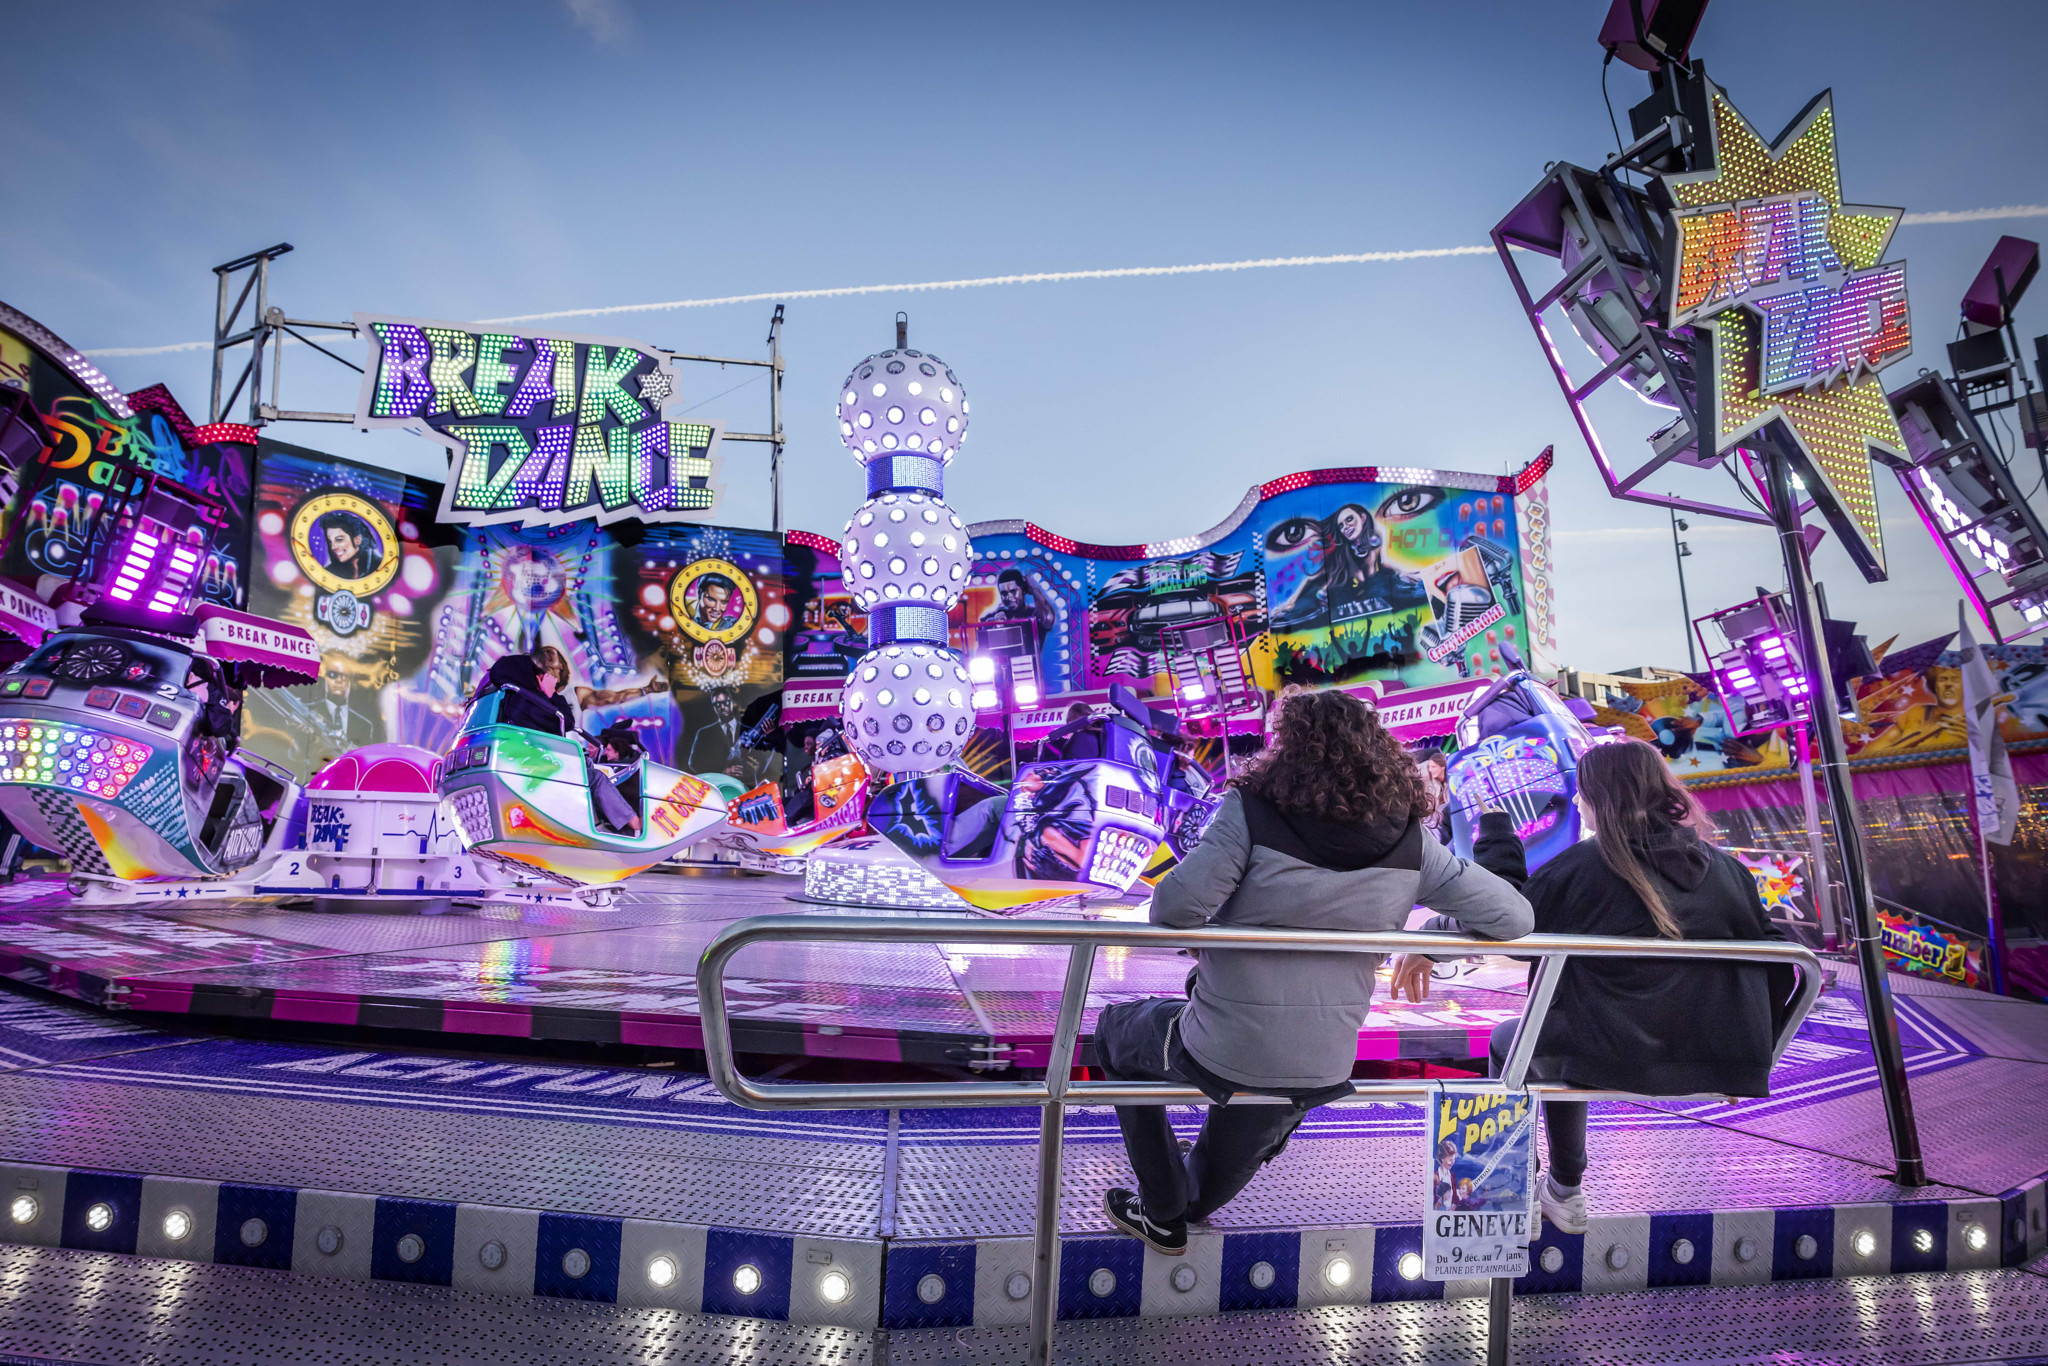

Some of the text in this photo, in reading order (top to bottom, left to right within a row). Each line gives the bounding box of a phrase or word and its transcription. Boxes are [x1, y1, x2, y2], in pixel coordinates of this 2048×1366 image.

[370, 322, 650, 425] BREAK
[443, 420, 714, 513] DANCE
[1388, 528, 1433, 548] HOT
[1528, 503, 1546, 570] BREAK
[10, 594, 45, 624] DANCE
[1535, 576, 1548, 644] DANCE
[228, 624, 312, 656] BREAK DANCE
[156, 684, 181, 700] 2
[793, 692, 834, 704] BREAK
[1026, 710, 1063, 725] BREAK
[1382, 707, 1423, 724] BREAK
[289, 861, 300, 876] 2
[453, 865, 463, 879] 3
[1877, 918, 1944, 968] umber
[1437, 1093, 1507, 1145] LUNA
[1463, 1096, 1529, 1154] PARK
[1436, 1254, 1448, 1264] Du
[1452, 1246, 1463, 1263] 9
[1482, 1254, 1492, 1262] au
[1494, 1244, 1503, 1260] 7
[1506, 1252, 1524, 1262] janv.
[1435, 1263, 1522, 1275] PLAINE DE PLAINPALAIS
